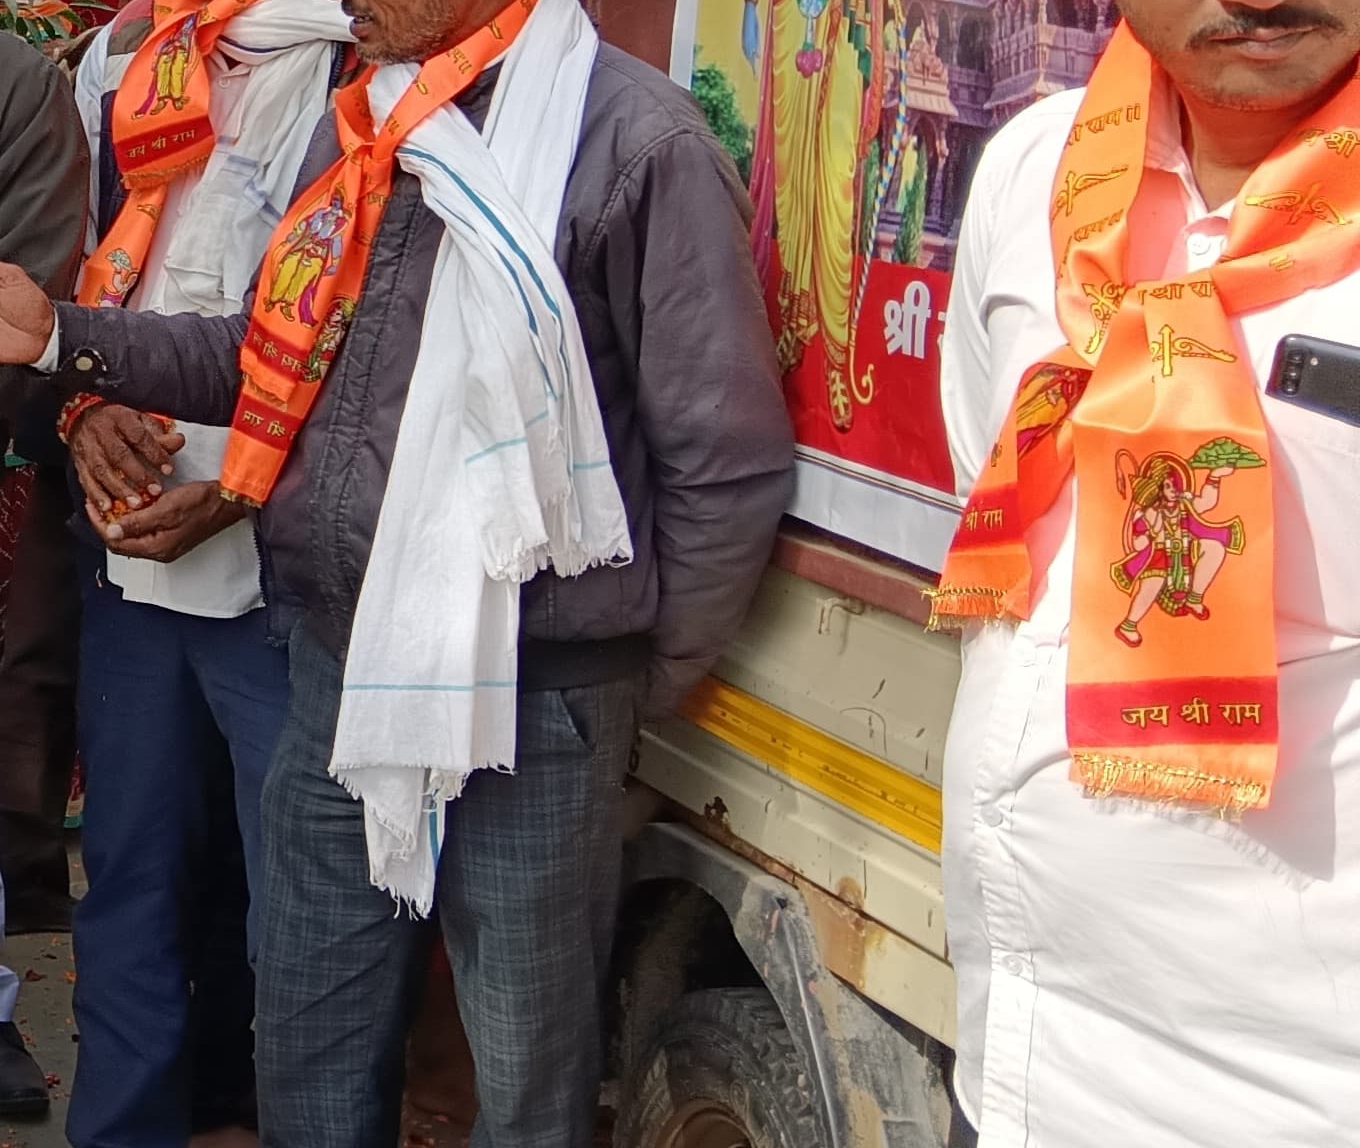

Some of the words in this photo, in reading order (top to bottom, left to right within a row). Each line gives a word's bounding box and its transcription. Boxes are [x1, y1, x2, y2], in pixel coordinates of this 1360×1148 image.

[883, 280, 931, 359] श्री
[982, 508, 1003, 529] राम
[1121, 705, 1170, 728] जय
[1180, 698, 1211, 726] श्री
[1219, 704, 1262, 726] राम
